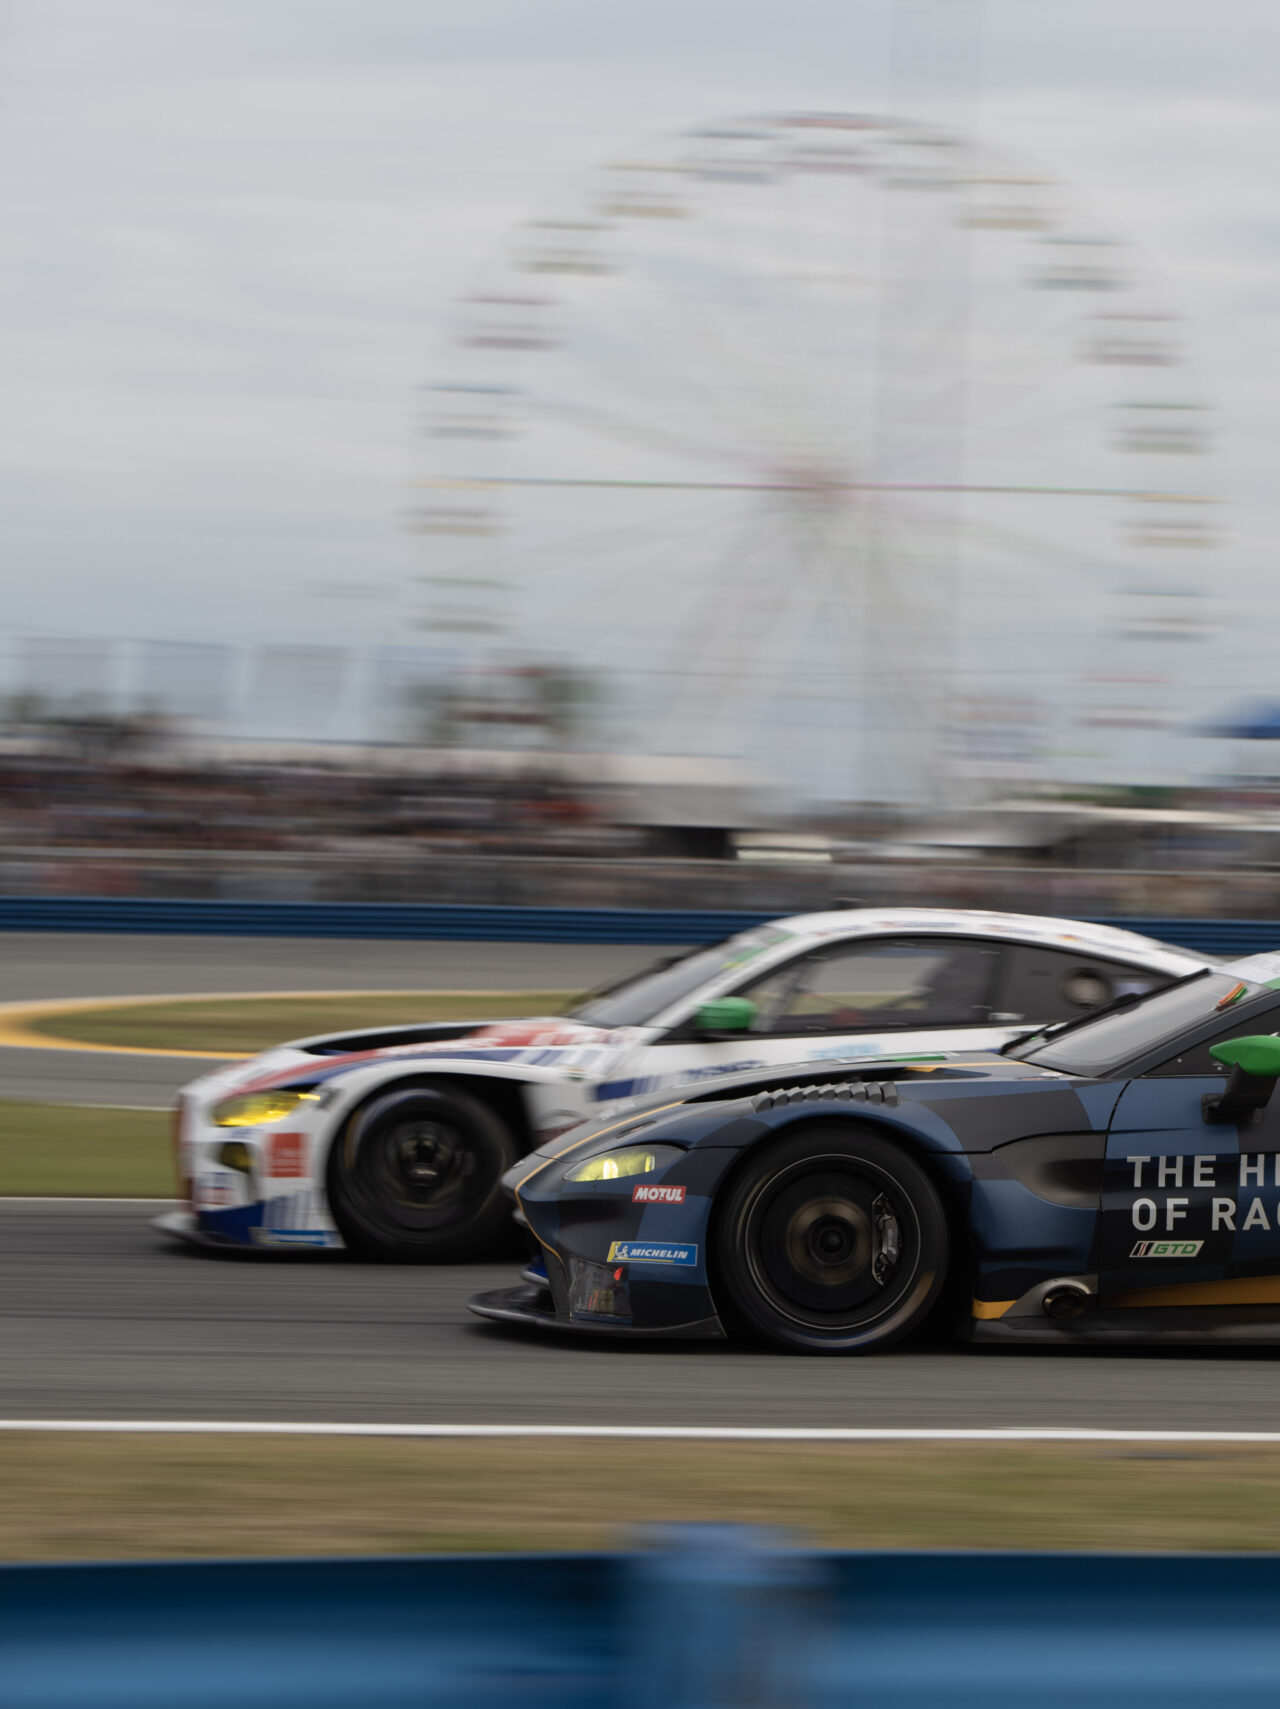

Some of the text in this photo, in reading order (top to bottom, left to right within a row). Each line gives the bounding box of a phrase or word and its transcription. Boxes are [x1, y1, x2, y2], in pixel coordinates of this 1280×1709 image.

[1126, 1155, 1216, 1188] THE
[634, 1187, 683, 1202] MOTUL
[1131, 1197, 1189, 1231] OF
[630, 1248, 688, 1259] MICHELIN
[1153, 1243, 1198, 1255] GTD
